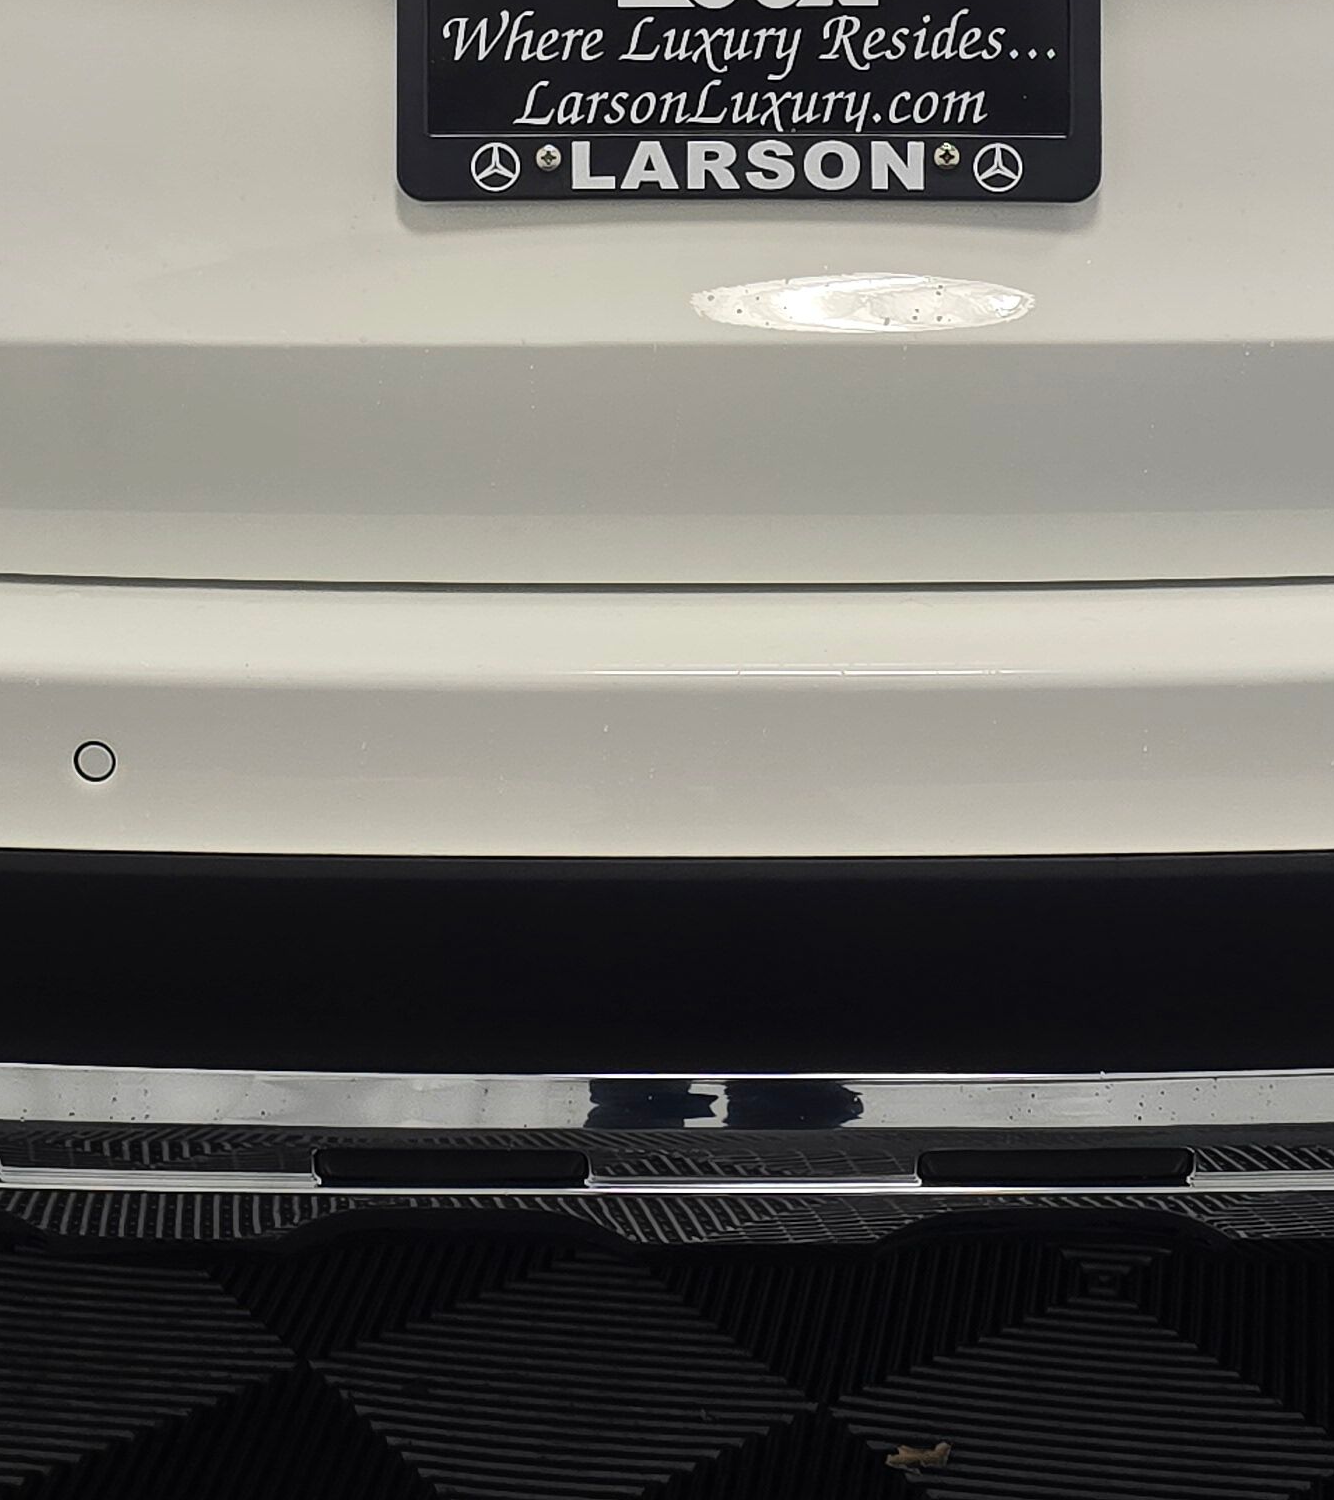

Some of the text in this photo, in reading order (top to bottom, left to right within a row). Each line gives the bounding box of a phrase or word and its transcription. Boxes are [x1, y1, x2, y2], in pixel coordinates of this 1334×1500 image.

[442, 8, 1056, 81] Where Luxury Resides...
[512, 79, 988, 133] LarsonLuxury.com
[571, 139, 925, 191] LARSON
